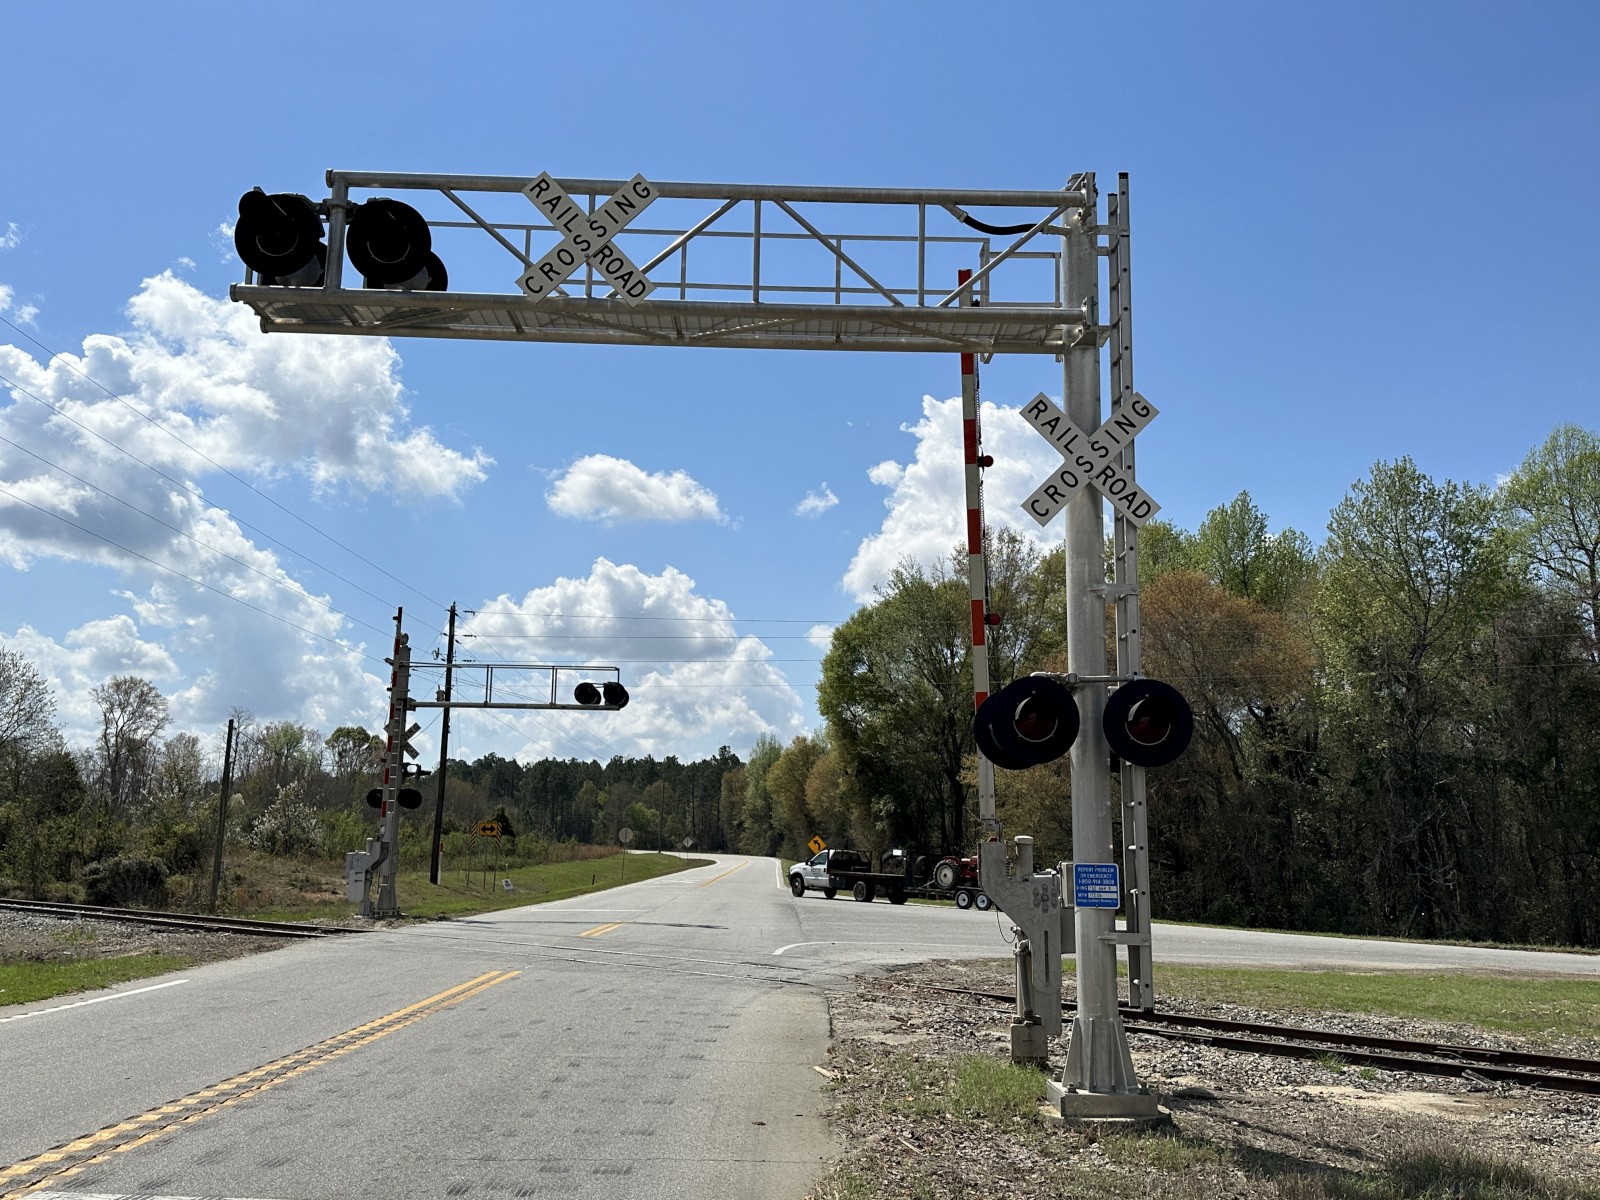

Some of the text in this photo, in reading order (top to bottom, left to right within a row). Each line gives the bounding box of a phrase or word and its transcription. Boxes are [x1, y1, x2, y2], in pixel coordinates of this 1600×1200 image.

[525, 181, 651, 294] CROSSING
[529, 178, 646, 298] RAIL ROAD
[1027, 399, 1152, 519] RAIL ROAD
[1030, 400, 1150, 517] CROSSING
